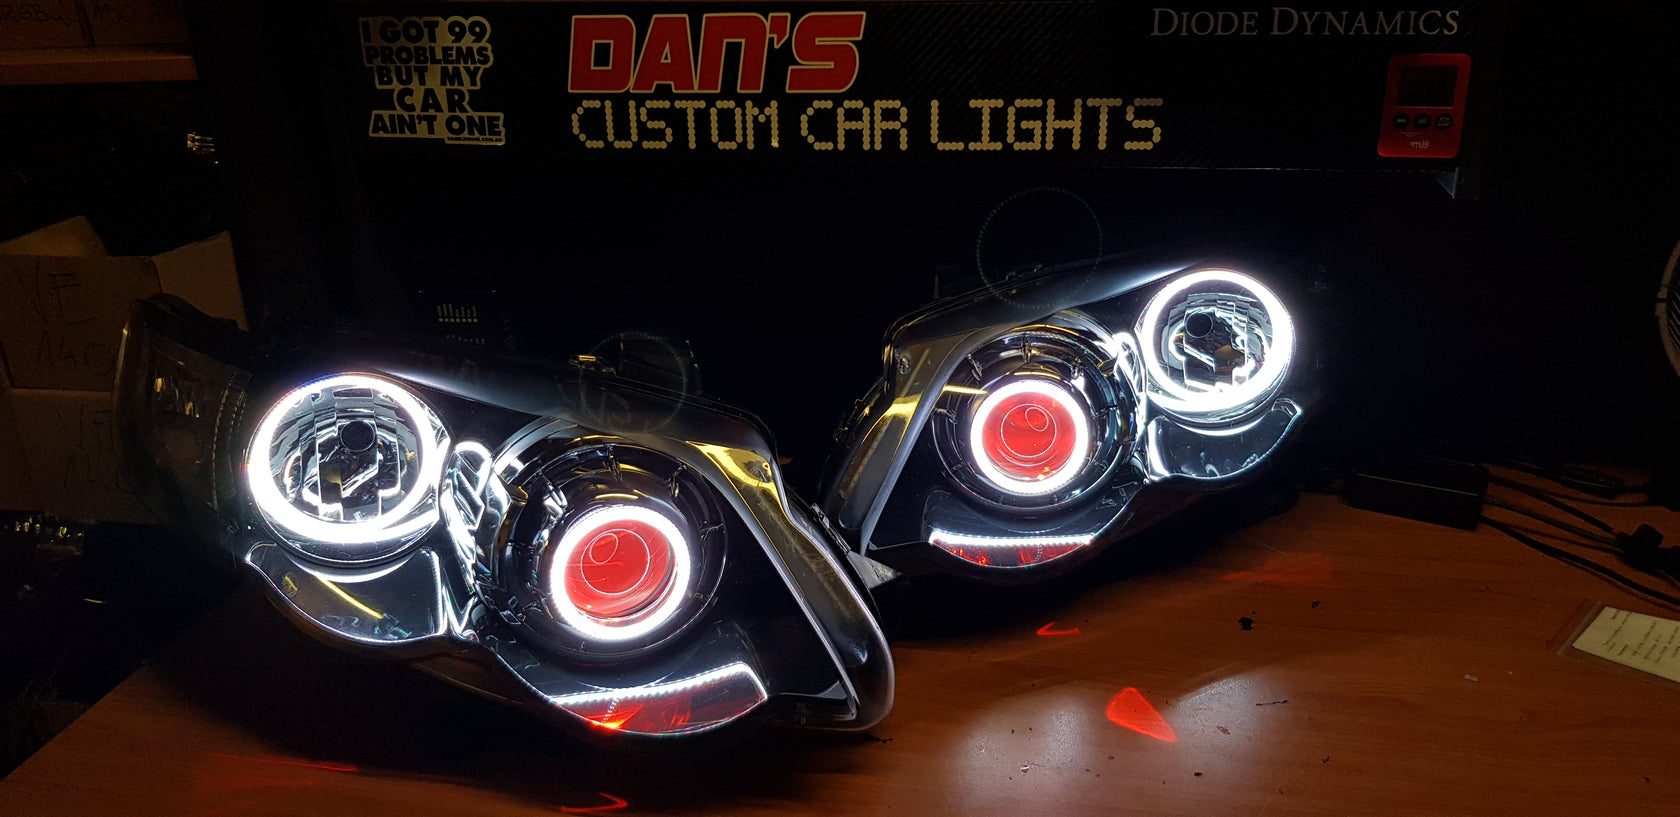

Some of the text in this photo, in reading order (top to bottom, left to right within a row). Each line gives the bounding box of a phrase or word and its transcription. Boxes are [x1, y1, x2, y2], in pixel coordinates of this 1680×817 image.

[361, 20, 487, 43] I GOT 99
[1150, 6, 1461, 37] DIODE DYNAMICS
[365, 46, 490, 65] PROBLEMS
[567, 11, 866, 94] DAN'S
[376, 66, 481, 86] BUT MY
[396, 88, 468, 113] CAR
[371, 114, 502, 137] AIN'T ONE
[570, 97, 1164, 151] CUSTOM CAR LIGHTS
